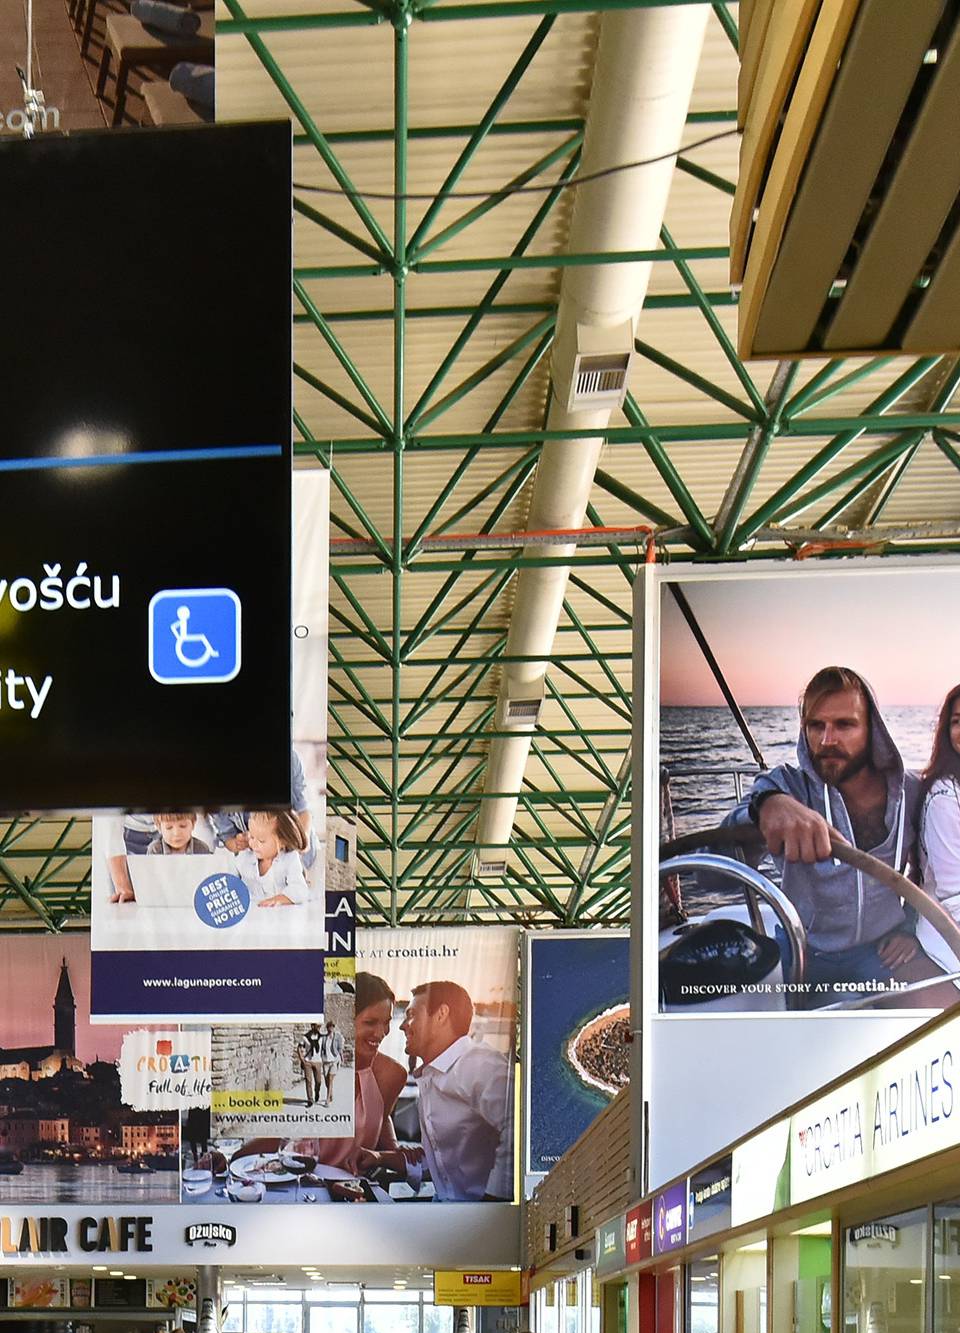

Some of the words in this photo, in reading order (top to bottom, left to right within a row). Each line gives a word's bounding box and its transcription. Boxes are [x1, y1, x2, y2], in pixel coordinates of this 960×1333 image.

[0, 562, 120, 612] ošću
[0, 668, 52, 719] ty
[201, 876, 228, 897] BEST
[206, 889, 239, 912] PRICE
[214, 913, 229, 925] NO
[228, 904, 245, 918] FEE
[370, 949, 384, 958] AT
[387, 945, 459, 958] croatia.hr
[143, 977, 262, 989] www.lagunaporec.com
[681, 985, 737, 995] DISCOVER
[741, 984, 772, 993] YOUR
[775, 983, 811, 993] STORY
[814, 983, 832, 992] AT
[833, 978, 908, 992] croatia.hr
[148, 1079, 172, 1094] Full
[174, 1079, 187, 1096] of
[229, 1096, 261, 1108] book
[264, 1099, 279, 1108] on
[215, 1112, 351, 1124] www.arenaturist.com
[803, 1101, 864, 1177] CROATIA
[872, 1050, 954, 1151] AIRLINES
[79, 1217, 153, 1252] CAFE
[465, 1275, 490, 1284] TISAK
